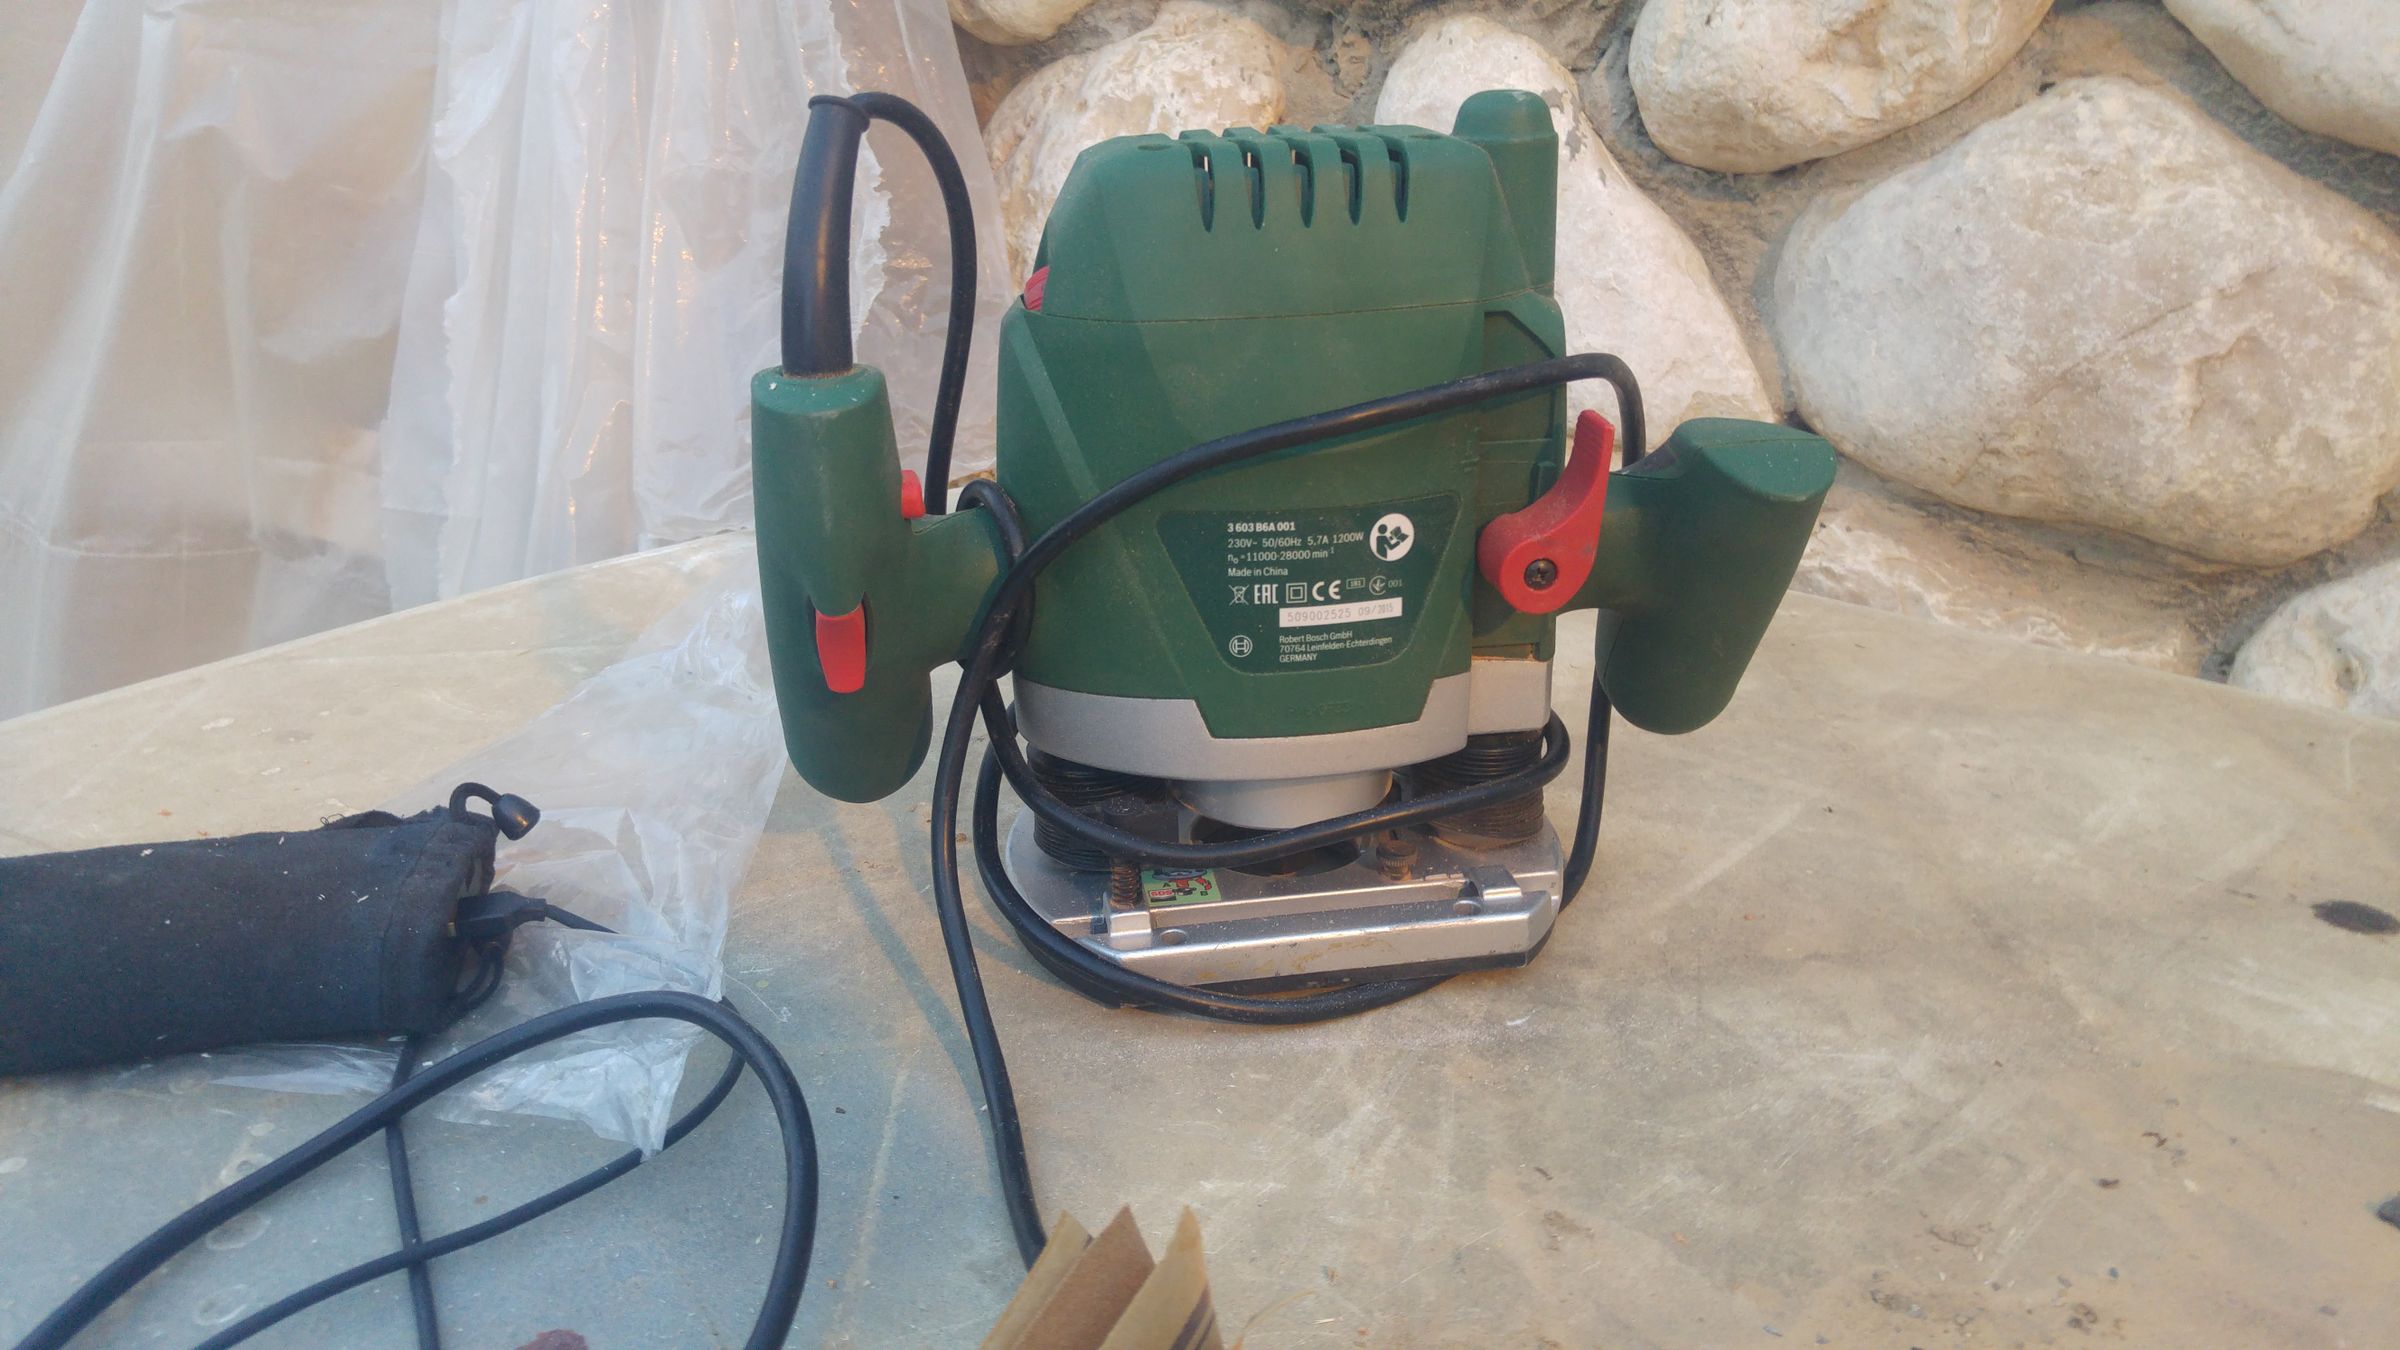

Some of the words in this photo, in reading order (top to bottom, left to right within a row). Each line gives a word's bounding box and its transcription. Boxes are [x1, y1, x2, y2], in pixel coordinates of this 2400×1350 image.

[1227, 523, 1234, 533] 3
[1235, 522, 1255, 533] 603
[1256, 522, 1276, 532] B6A
[1277, 521, 1296, 532] 001
[1262, 536, 1302, 548] 50/60Hz
[1333, 532, 1364, 545] 1200W
[1228, 568, 1252, 577] Made
[1253, 567, 1262, 576] in
[1263, 567, 1288, 576] China
[1280, 635, 1305, 644] Robert
[1306, 633, 1329, 642] Bosch
[1330, 631, 1353, 640] GmbH
[1280, 645, 1306, 654] 70764
[1307, 637, 1393, 652] Leinfelden-Echterdingen
[1280, 654, 1317, 663] GERMANY
